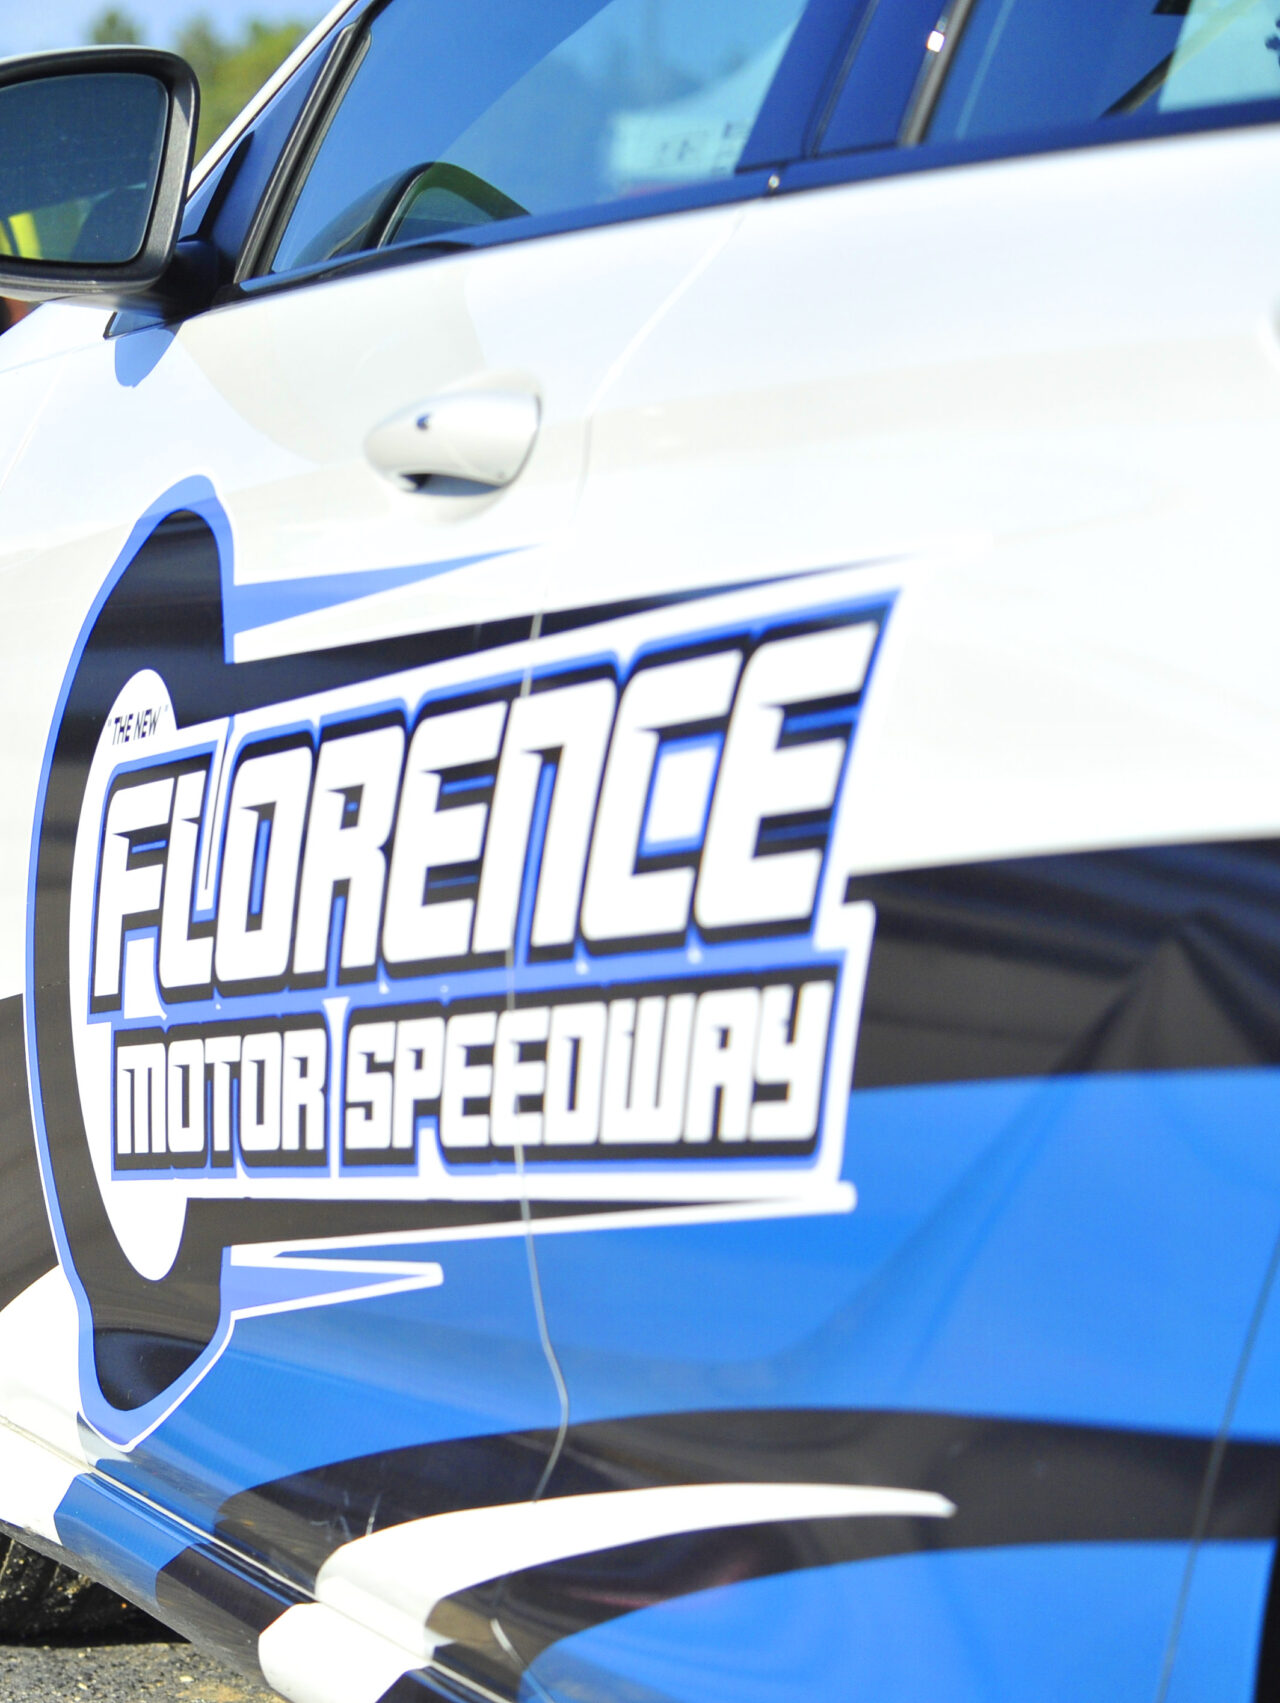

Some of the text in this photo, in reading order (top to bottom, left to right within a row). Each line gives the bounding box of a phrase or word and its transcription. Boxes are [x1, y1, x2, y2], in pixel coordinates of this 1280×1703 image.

[92, 620, 881, 998] FLORENCE
[115, 979, 837, 1155] MOTOR SPEEDWAY
